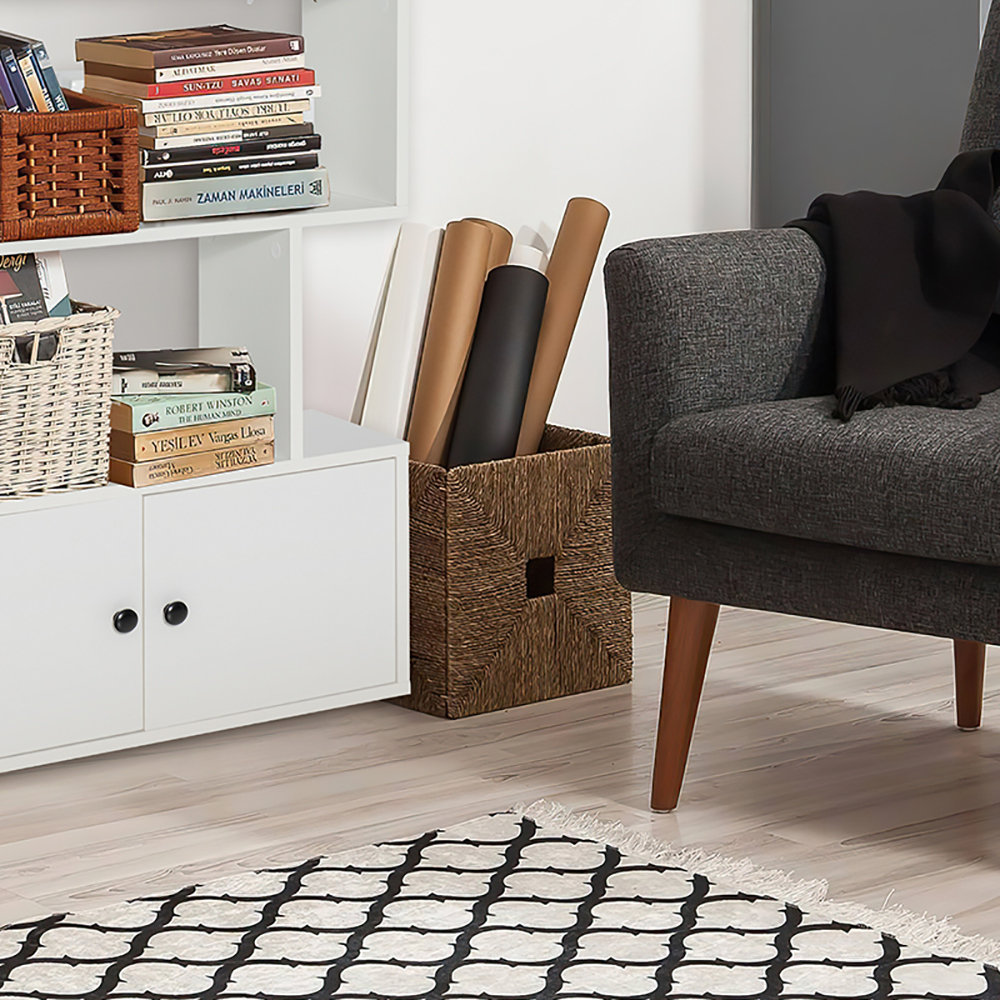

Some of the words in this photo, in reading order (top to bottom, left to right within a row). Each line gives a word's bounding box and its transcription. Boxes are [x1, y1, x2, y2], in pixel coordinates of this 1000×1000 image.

[197, 190, 236, 204] ZAMAN
[239, 181, 305, 200] MAKİNELERİ
[165, 401, 203, 416] ROBERT
[206, 396, 253, 410] WINSTON
[208, 431, 239, 444] Vargas
